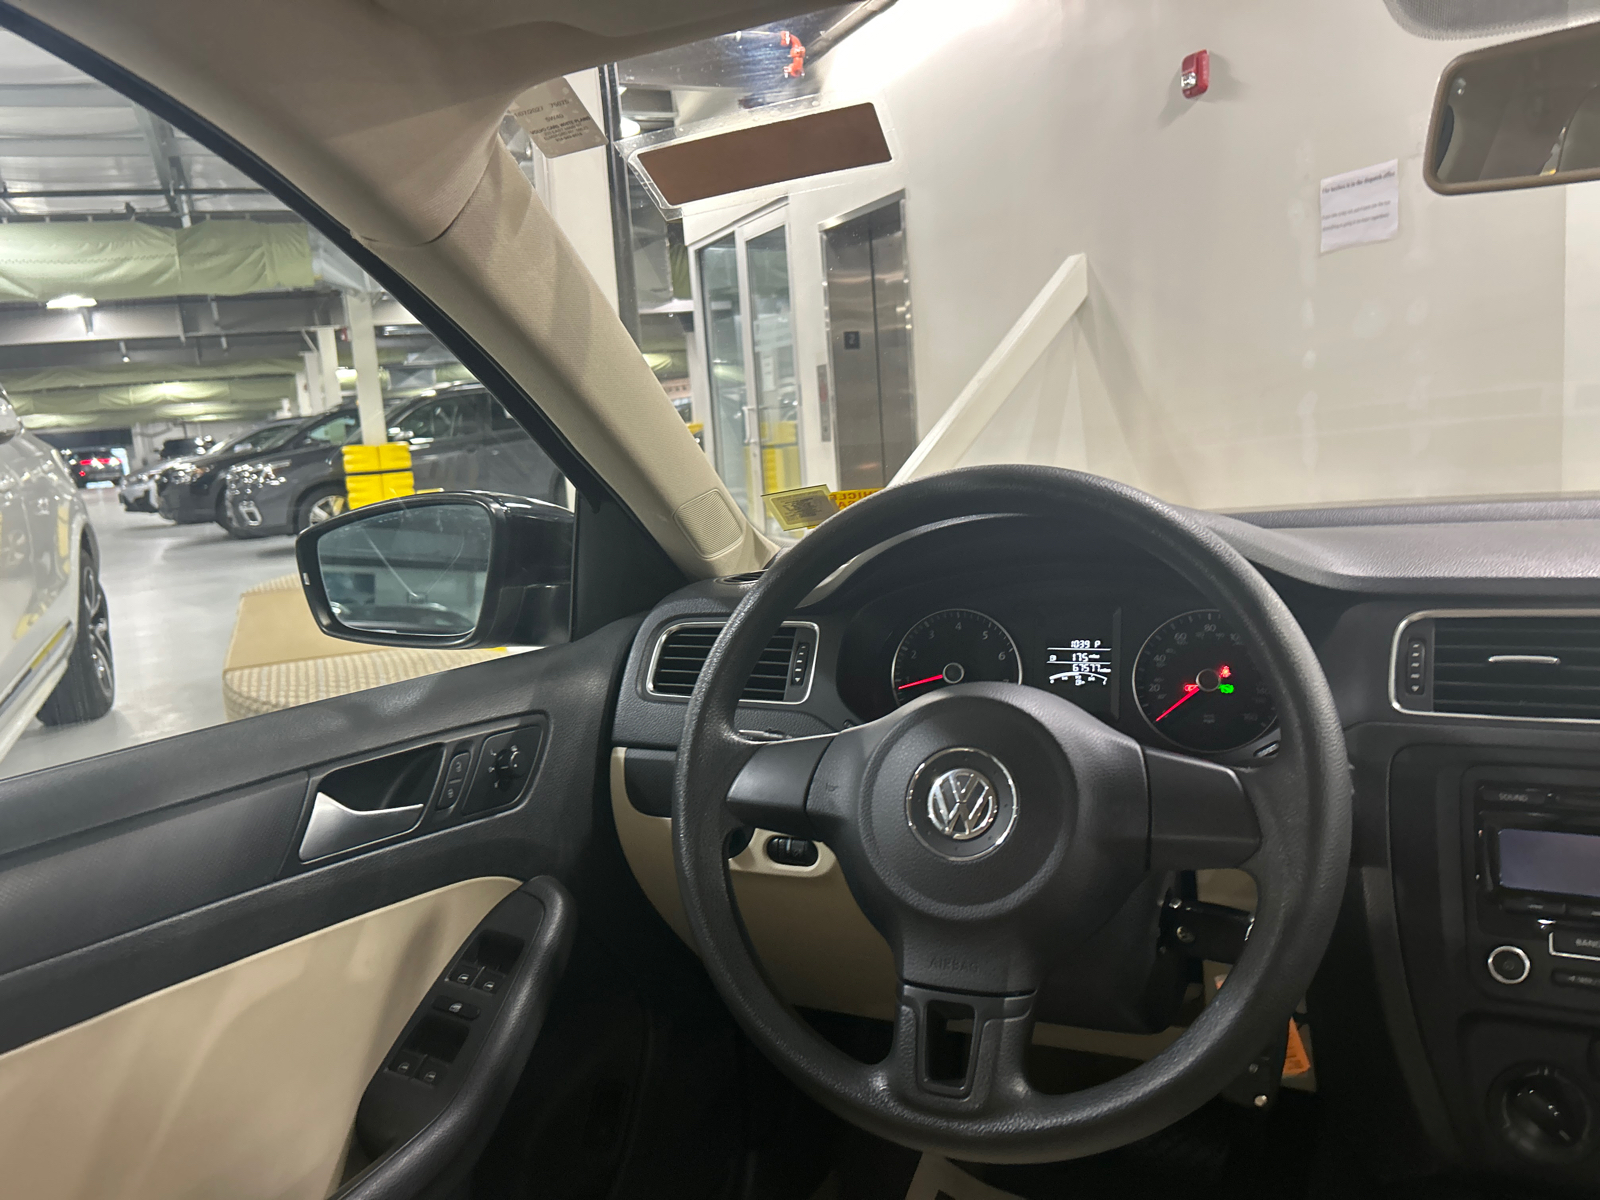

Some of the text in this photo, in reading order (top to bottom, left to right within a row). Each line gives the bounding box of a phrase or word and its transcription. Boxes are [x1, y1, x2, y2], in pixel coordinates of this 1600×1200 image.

[954, 621, 962, 631] 4
[1203, 623, 1217, 632] 80
[928, 630, 935, 640] 3
[982, 630, 989, 640] 5
[1094, 640, 1101, 648] P
[910, 650, 917, 660] 2
[998, 651, 1006, 661] 6
[1072, 652, 1089, 662] 175
[1153, 654, 1167, 663] 40
[1072, 663, 1101, 672] 67577
[1148, 683, 1161, 692] 20
[1498, 792, 1529, 803] SOUND
[929, 956, 980, 972] AIRBAG
